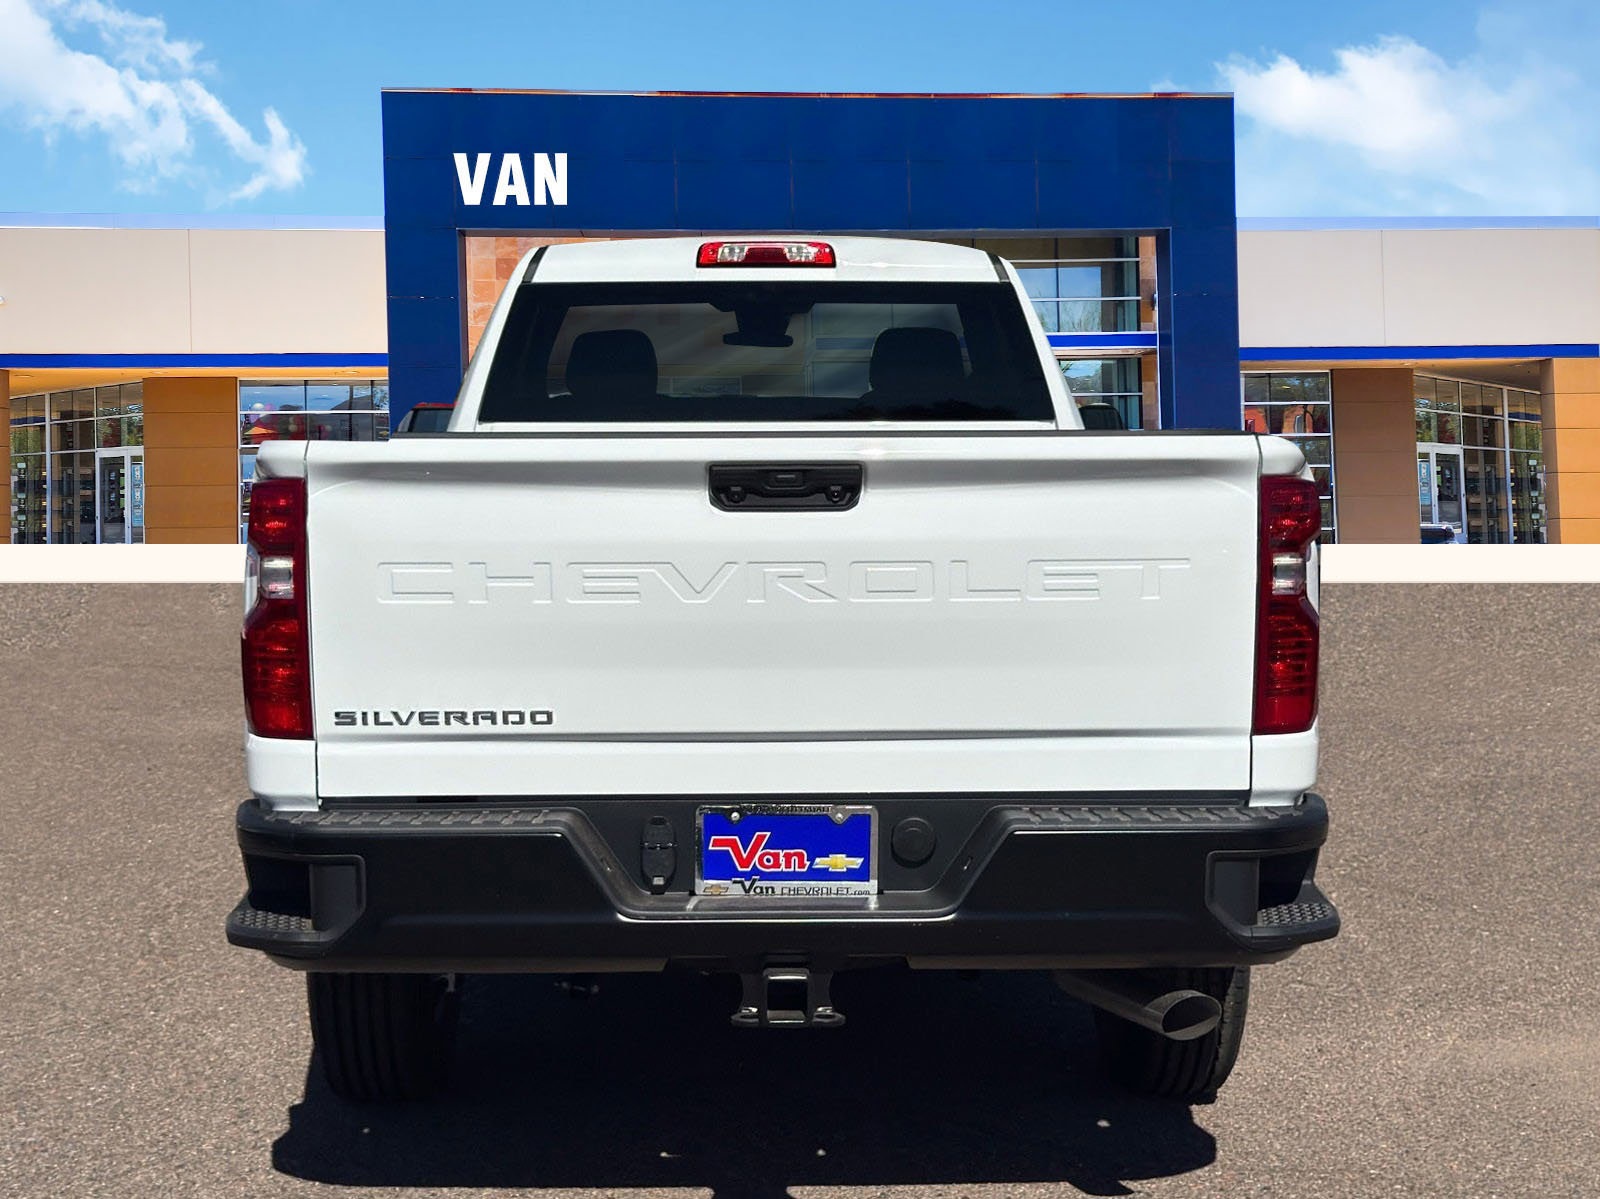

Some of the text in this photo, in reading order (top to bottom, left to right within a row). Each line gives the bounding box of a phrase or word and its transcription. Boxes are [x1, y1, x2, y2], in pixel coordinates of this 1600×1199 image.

[453, 152, 568, 206] VAN
[377, 558, 1192, 604] CHEVROLET
[334, 711, 554, 726] SILVERADO
[708, 831, 811, 872] Van
[731, 876, 776, 895] Van
